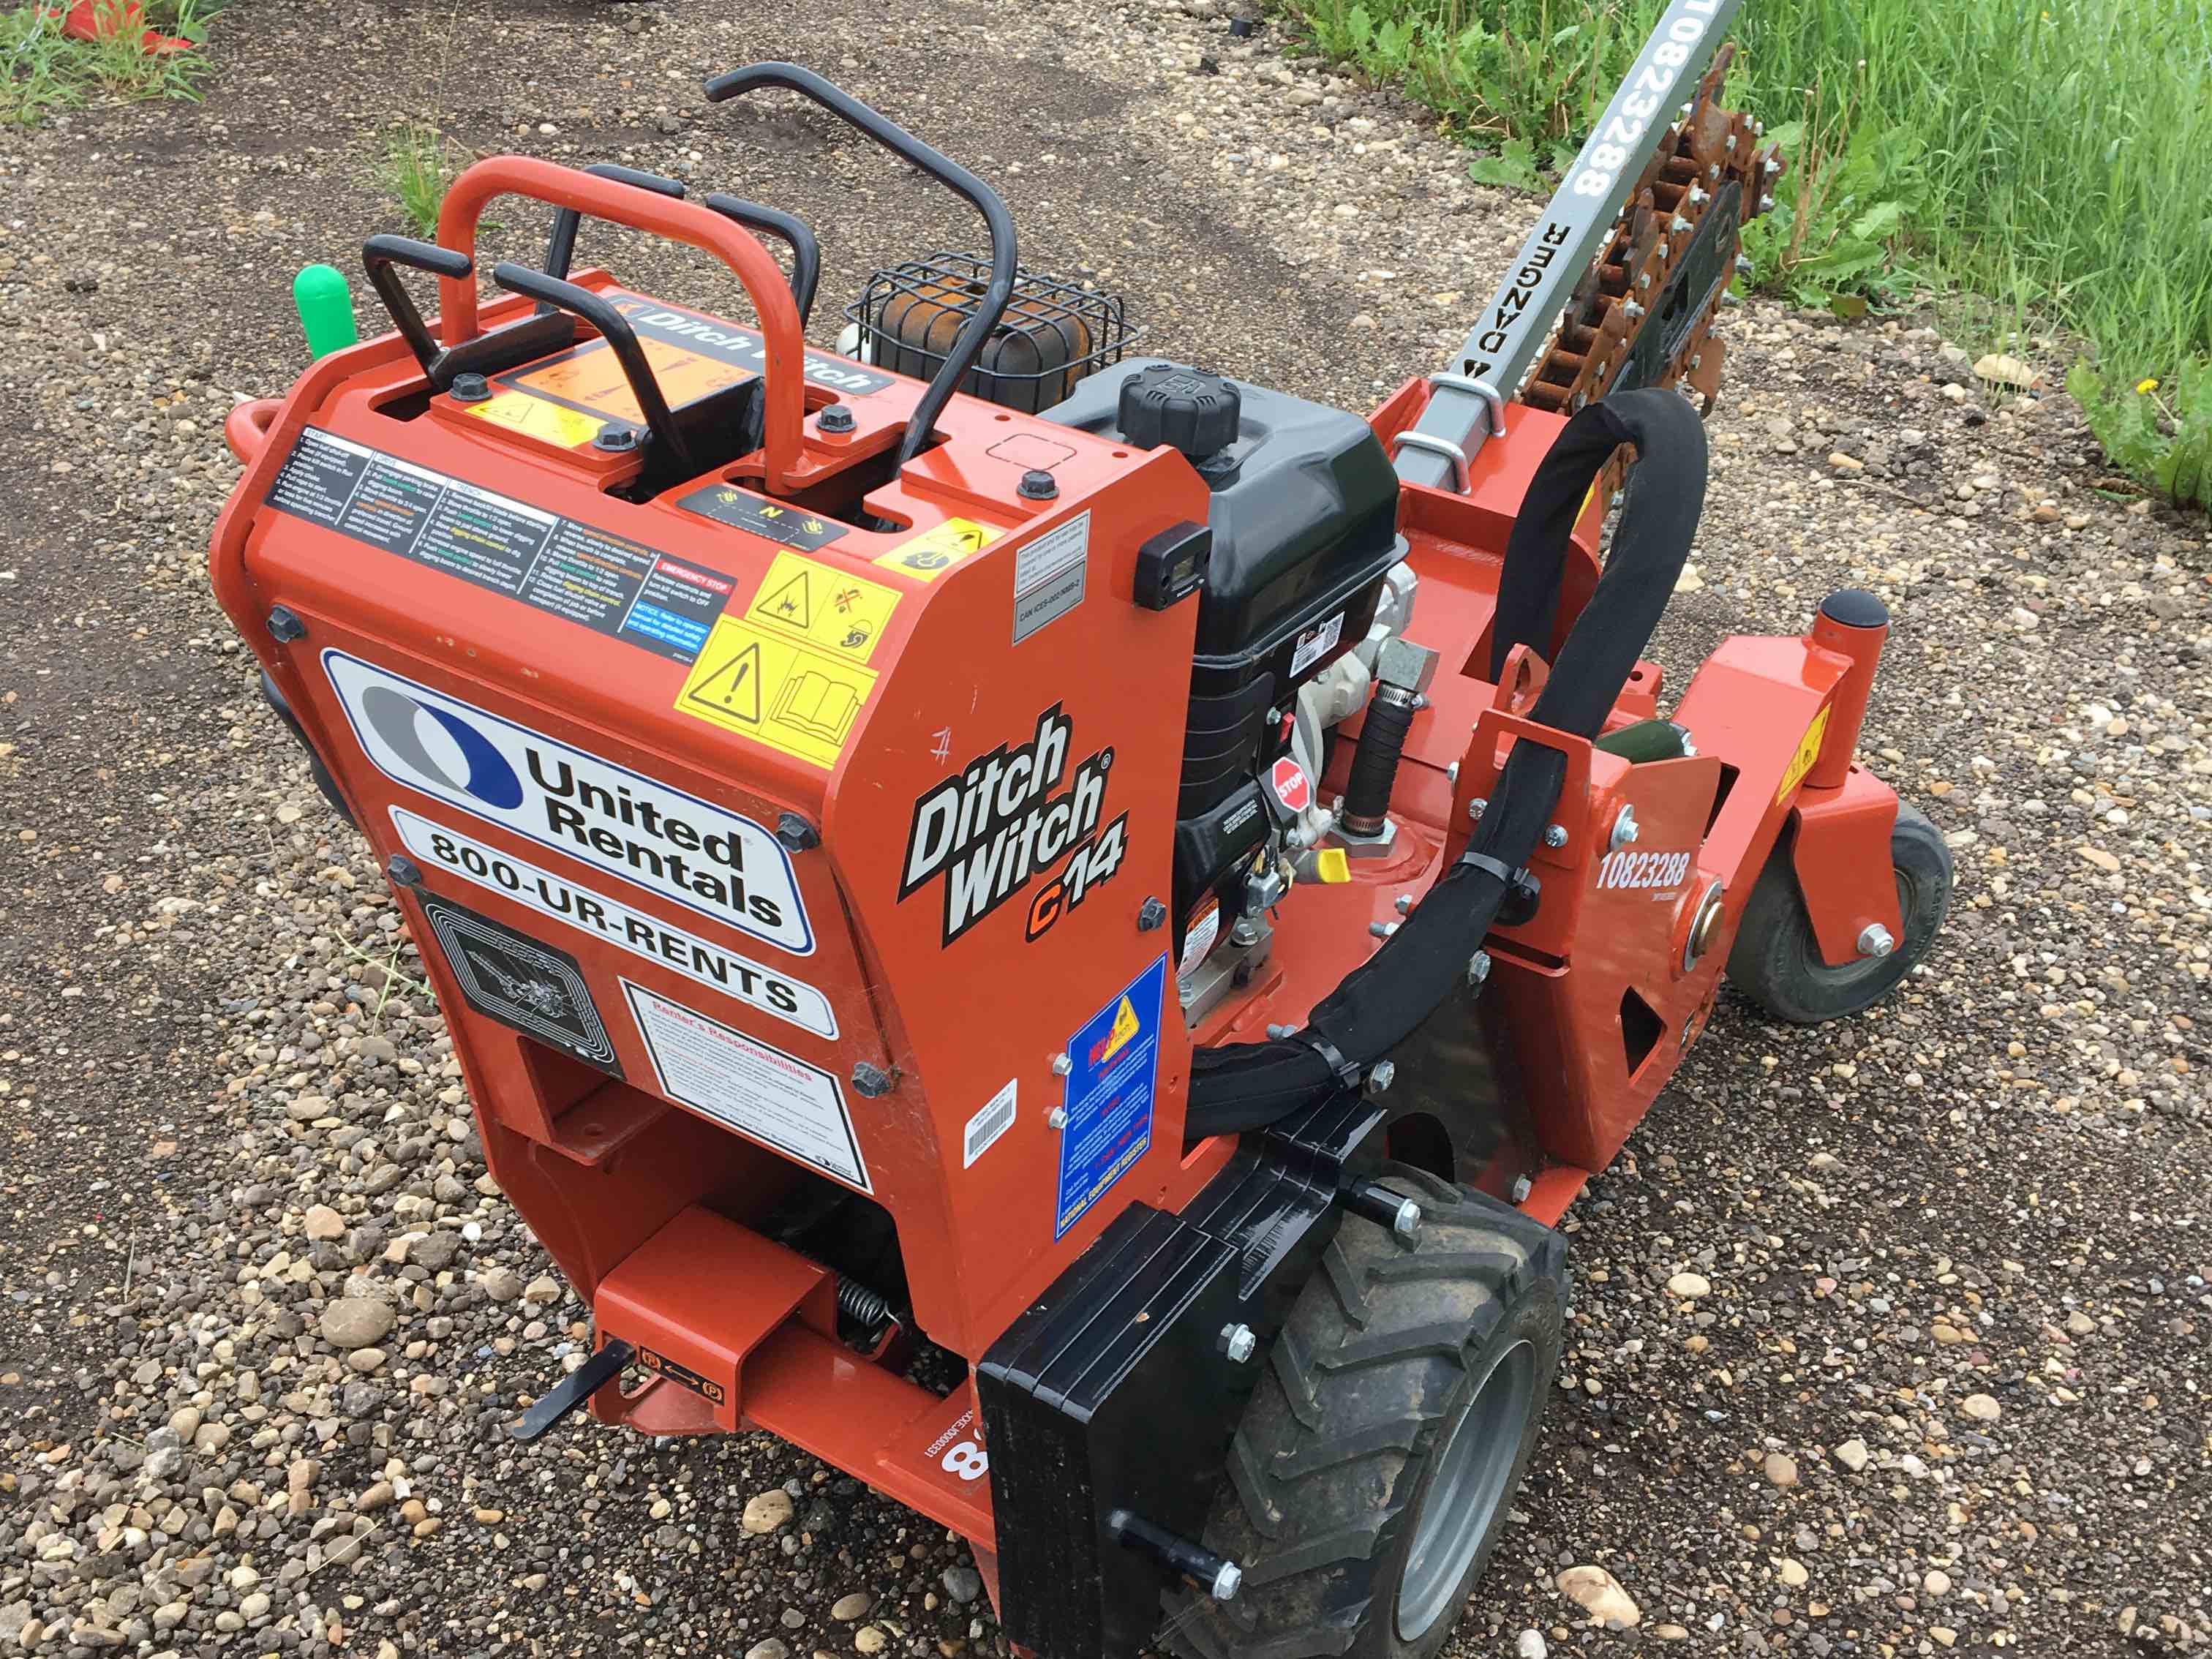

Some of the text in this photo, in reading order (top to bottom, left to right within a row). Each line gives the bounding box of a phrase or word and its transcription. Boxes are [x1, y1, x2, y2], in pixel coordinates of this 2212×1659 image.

[1573, 0, 1718, 197] 10823288
[638, 312, 753, 351] Ditch
[1479, 222, 1570, 354] DANGER
[759, 506, 784, 518] N
[661, 562, 727, 591] EMERGENCY STOP
[525, 748, 745, 873] United
[906, 716, 1067, 887] Ditch
[1279, 772, 1304, 798] STOP
[545, 796, 783, 928] Rentals
[949, 766, 1103, 936] Witch
[1596, 851, 1690, 889] 10823288
[431, 834, 798, 1014] 800-UR-RENTS
